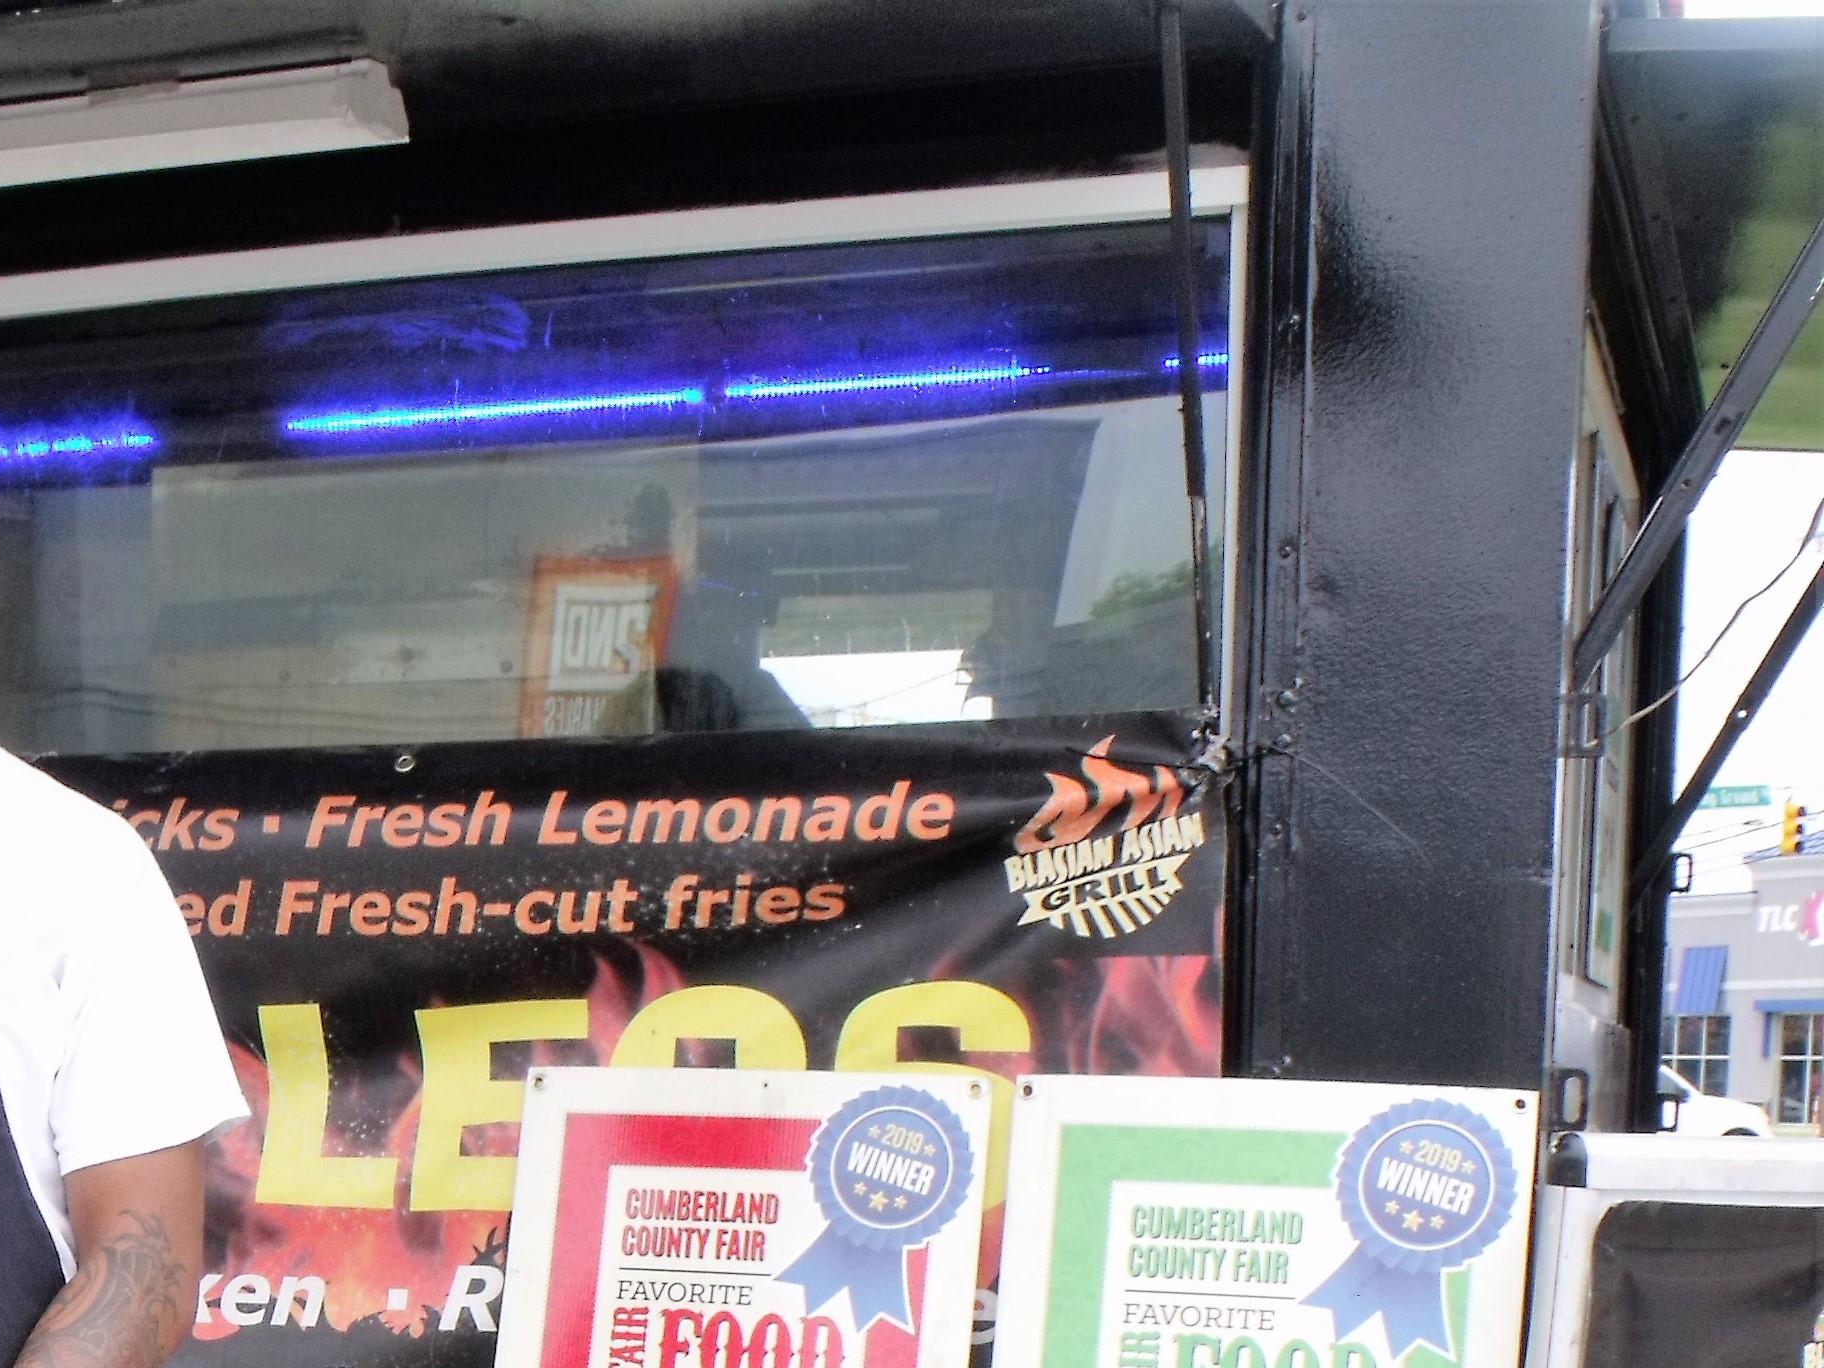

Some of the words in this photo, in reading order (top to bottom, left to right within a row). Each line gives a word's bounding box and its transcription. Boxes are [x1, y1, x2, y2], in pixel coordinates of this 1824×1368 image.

[113, 797, 240, 851] cks
[305, 789, 512, 849] Fresh
[537, 779, 957, 846] Lemonade
[1004, 835, 1116, 893] BLASIAN
[1120, 811, 1205, 864] ASIAN
[274, 875, 638, 936] Fresh-cut
[664, 872, 846, 931] fries
[1041, 862, 1169, 911] GRILL
[1757, 904, 1800, 933] TLC
[881, 1123, 924, 1154] 2019
[1414, 1139, 1463, 1172] 2019
[846, 1142, 937, 1196] WINNER
[1377, 1157, 1476, 1216] WINNER
[624, 1188, 780, 1226] CUMBERLAND
[1131, 1205, 1304, 1245] CUMBERLAND
[621, 1224, 714, 1261] COUNTY
[714, 1231, 767, 1262] FAIR
[1128, 1243, 1226, 1282] COUNTY
[1232, 1249, 1290, 1285] FAIR
[616, 1280, 753, 1306] FAVORITE
[1123, 1303, 1275, 1331] FAVORITE
